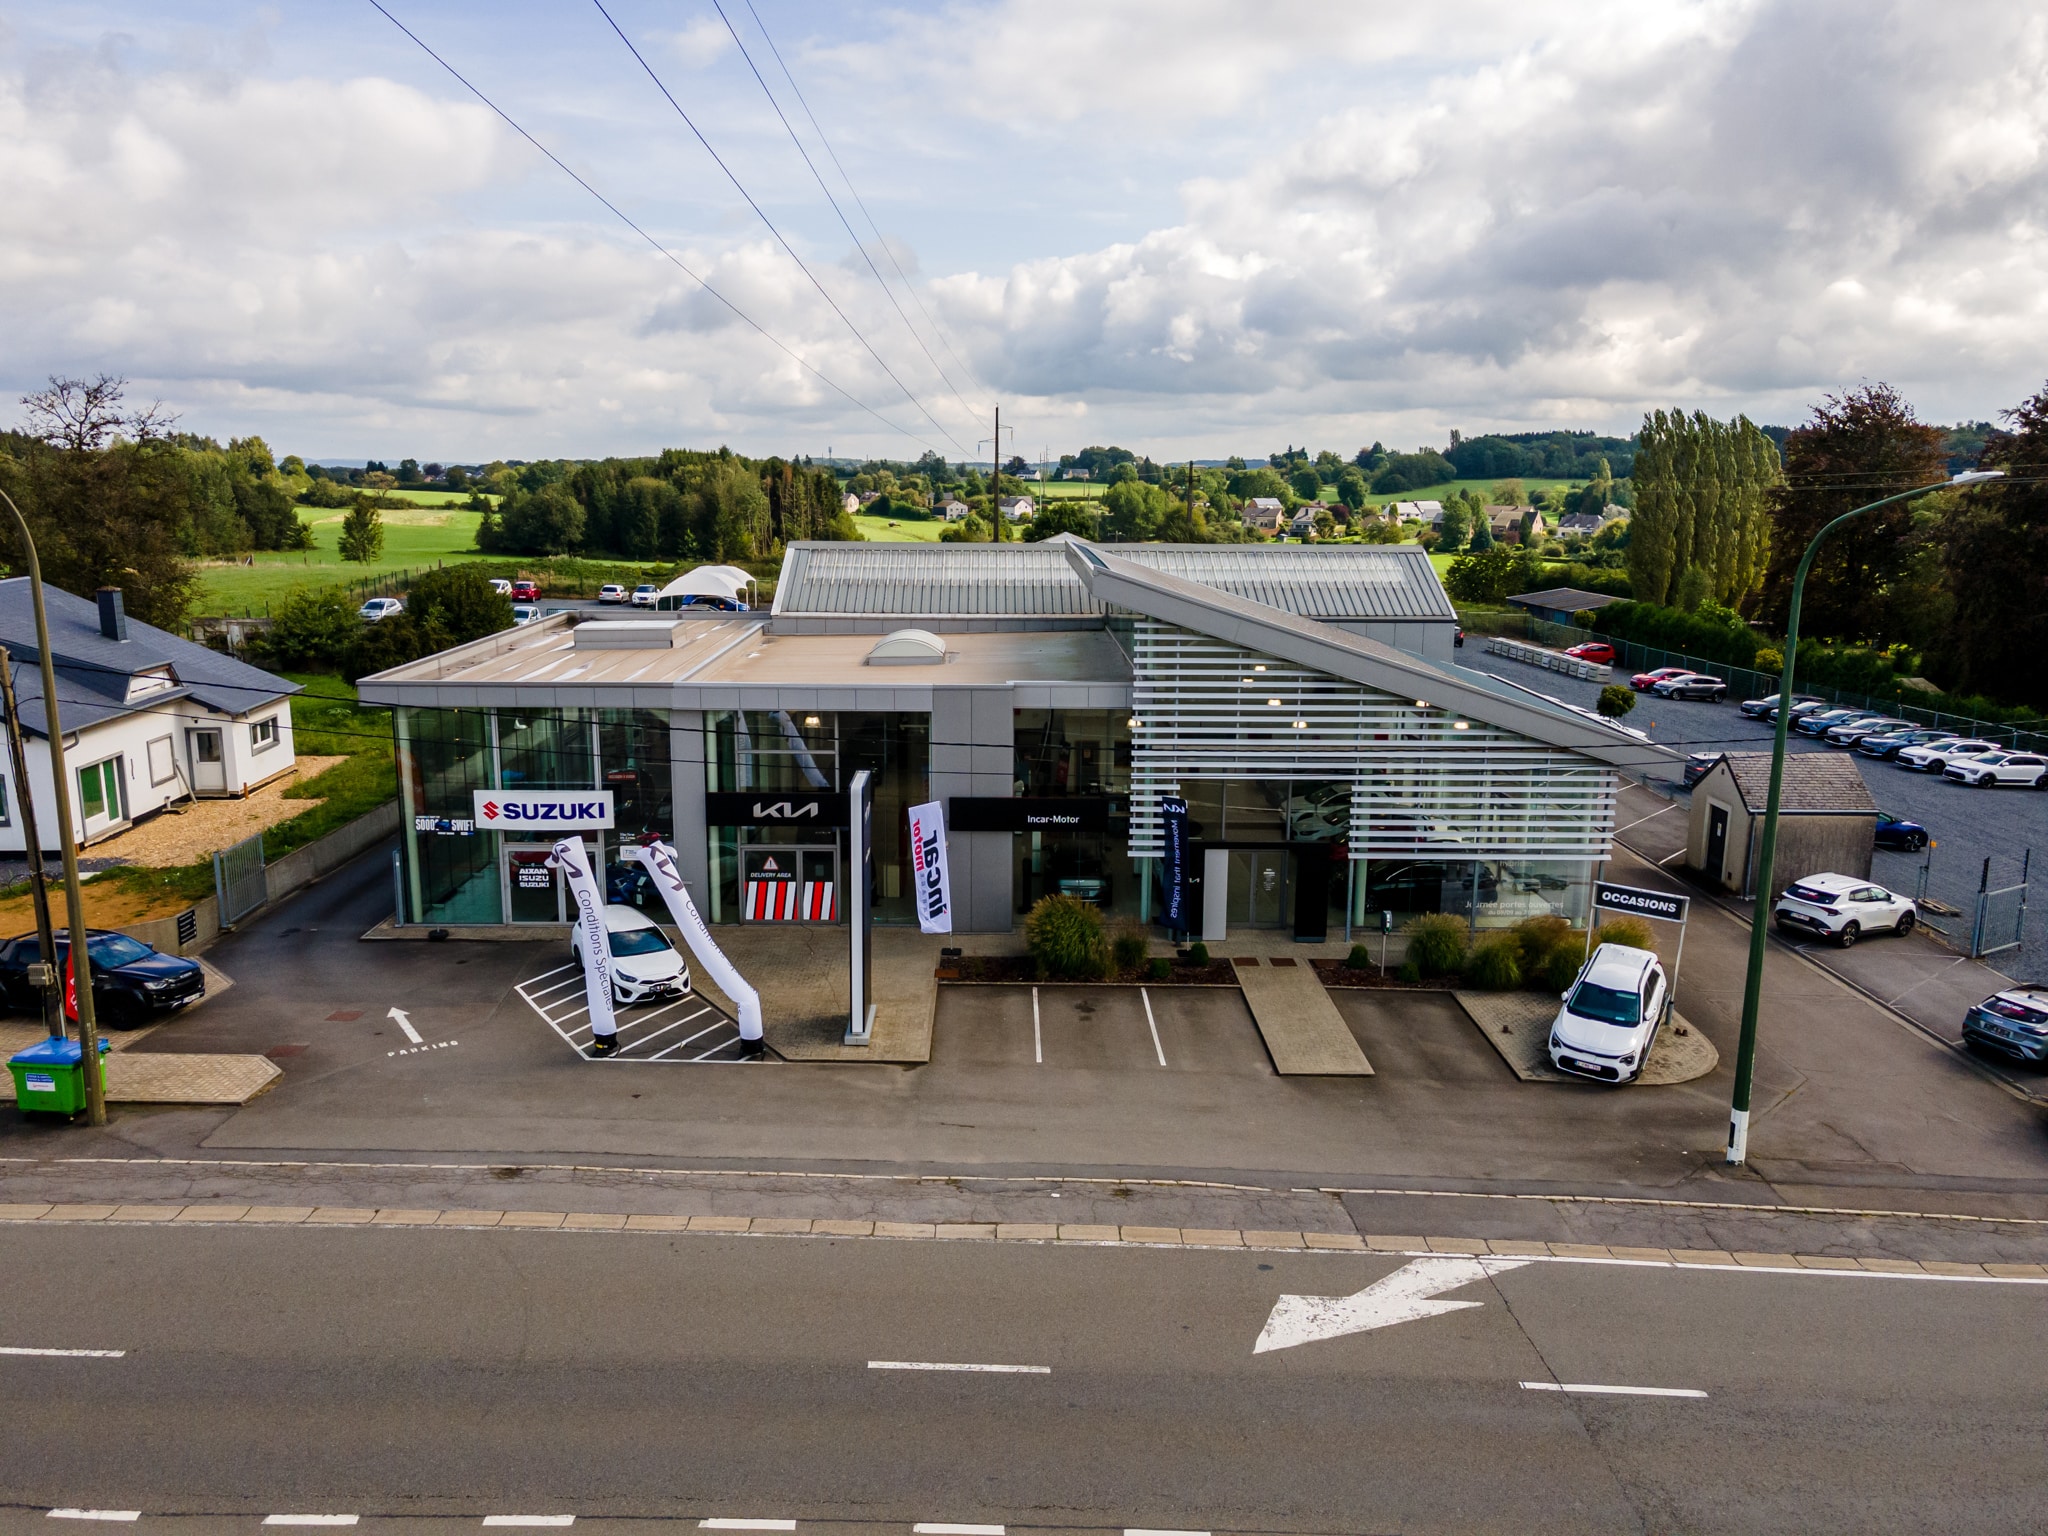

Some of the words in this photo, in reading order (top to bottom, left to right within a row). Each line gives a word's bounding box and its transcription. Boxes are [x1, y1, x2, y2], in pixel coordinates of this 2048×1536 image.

[503, 802, 605, 820] SUZUKI
[753, 802, 818, 818] KIA
[451, 819, 474, 831] SWIFT
[1026, 814, 1080, 825] Incar-Motor
[1499, 901, 1526, 910] portes
[1601, 891, 1678, 913] OCCASIONS
[578, 889, 602, 956] Conditions
[387, 1040, 458, 1057] PARKING
